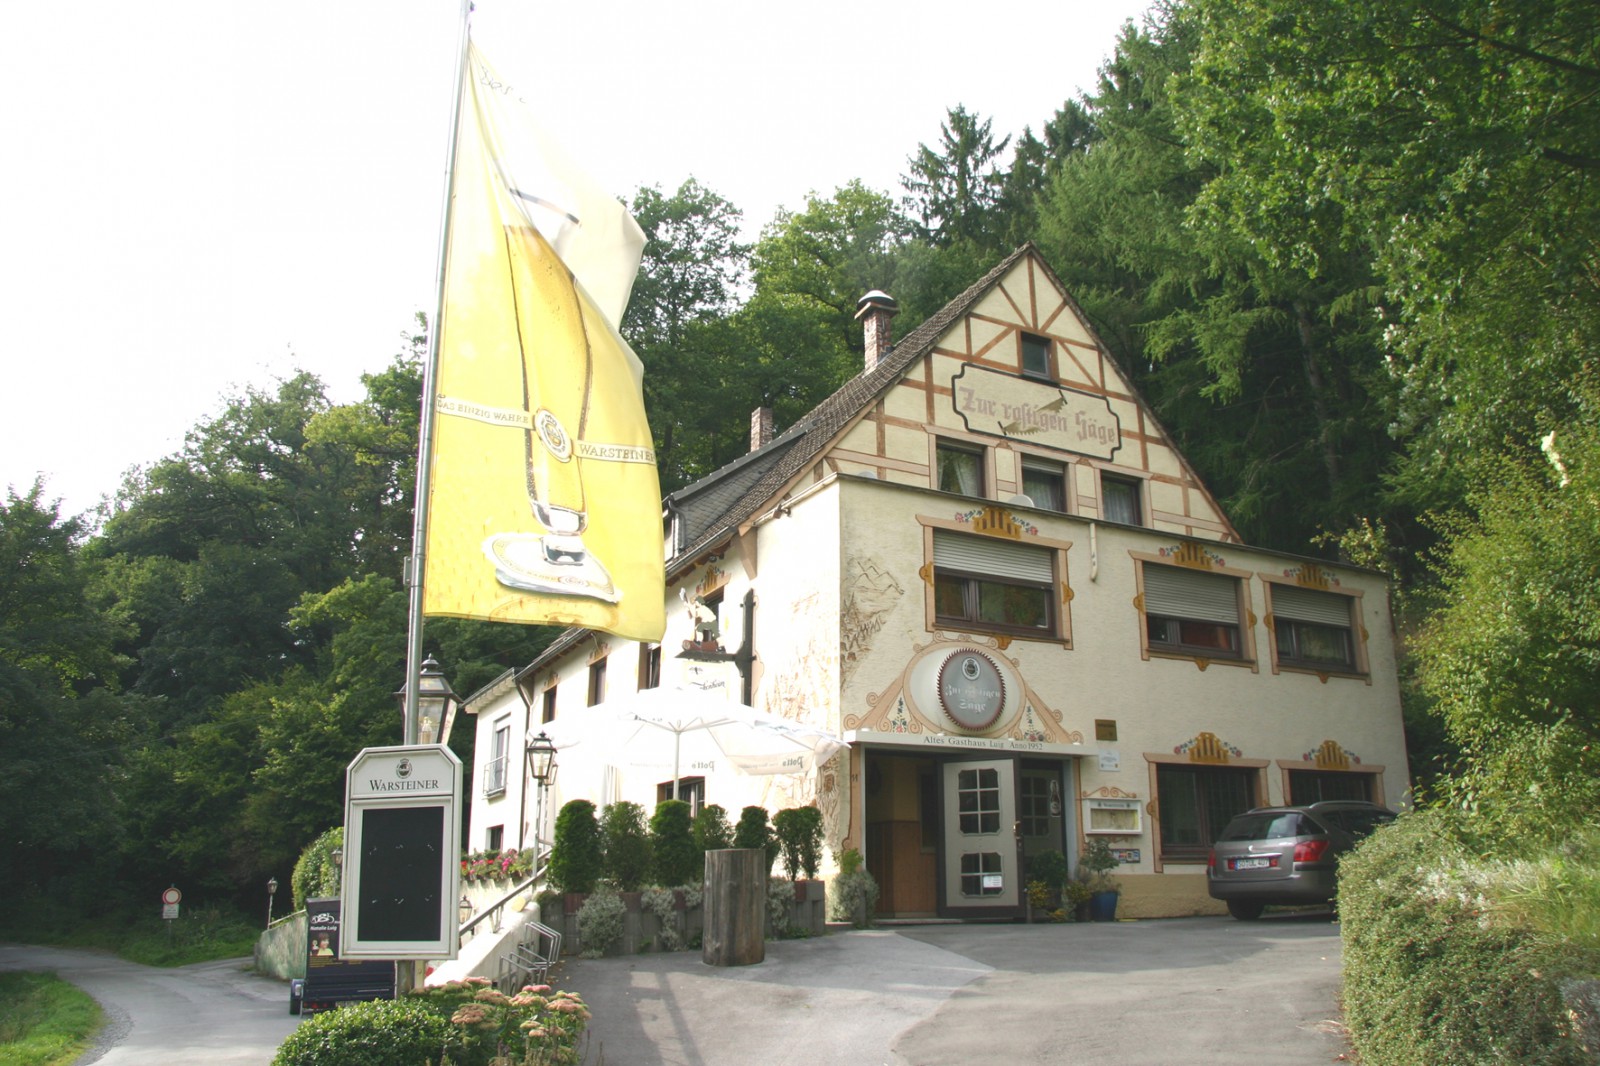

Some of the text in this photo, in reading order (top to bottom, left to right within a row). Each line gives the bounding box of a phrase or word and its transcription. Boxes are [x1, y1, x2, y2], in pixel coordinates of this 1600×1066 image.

[437, 399, 529, 424] DAS EINZIG WAHRE
[958, 386, 997, 417] Zur
[1074, 410, 1116, 445] Säge
[964, 687, 1001, 699] rtigen
[923, 736, 944, 745] Altes
[948, 738, 986, 747] Gasthaus
[1009, 742, 1027, 750] Anno
[1028, 743, 1043, 751] 1952
[369, 779, 439, 791] WARSTEINER
